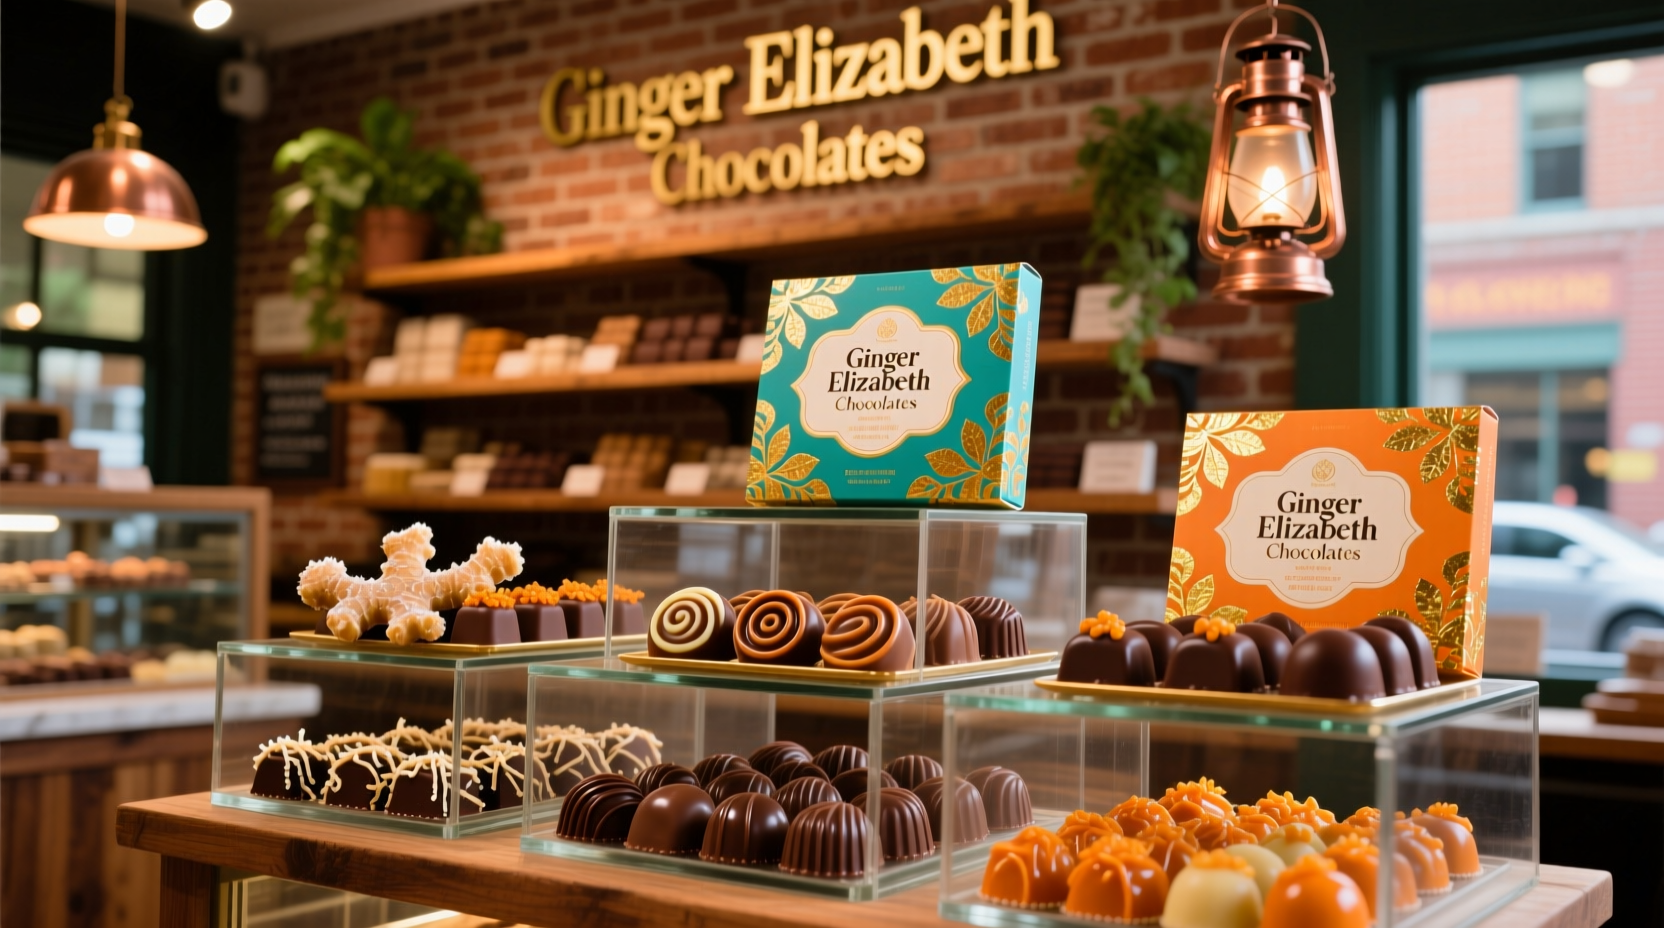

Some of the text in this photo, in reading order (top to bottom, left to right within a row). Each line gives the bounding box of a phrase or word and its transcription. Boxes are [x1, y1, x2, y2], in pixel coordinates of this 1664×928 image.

[539, 0, 1060, 153] Ginger Elizabeth
[650, 120, 926, 205] Chocolates
[846, 347, 920, 374] Ginger
[827, 368, 930, 393] Elizabeth
[1277, 490, 1363, 521] Ginger
[1256, 514, 1377, 541] Elizabeth
[1266, 542, 1361, 561] Chocolates
